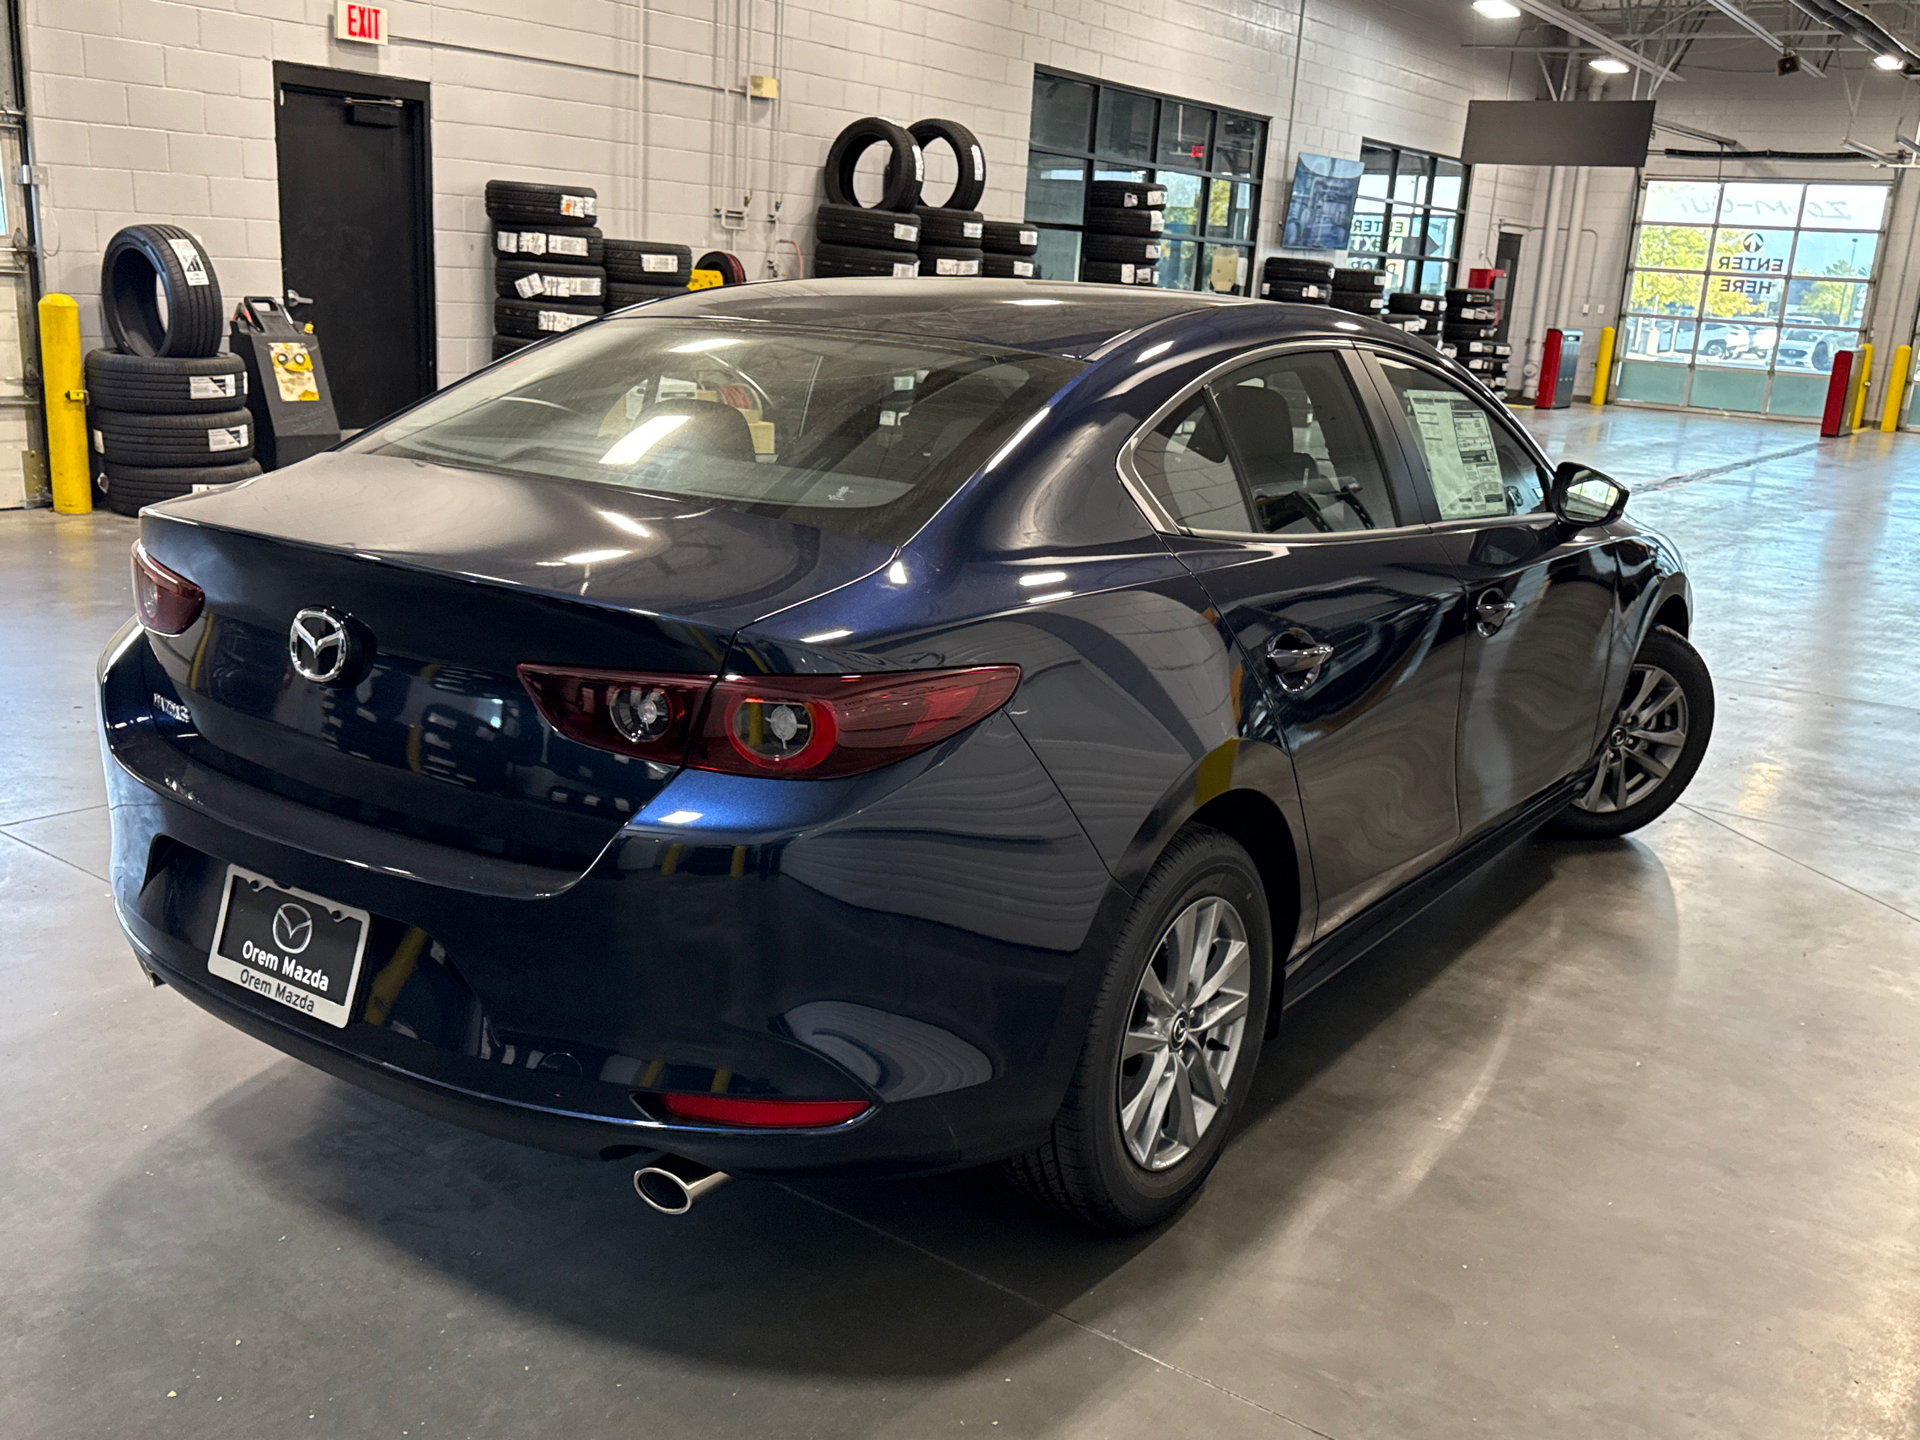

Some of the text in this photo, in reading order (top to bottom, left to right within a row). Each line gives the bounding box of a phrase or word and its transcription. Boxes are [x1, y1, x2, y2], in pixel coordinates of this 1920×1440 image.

[347, 4, 381, 40] EXIT
[242, 940, 329, 992] Orem Mazda
[240, 969, 315, 1013] Orem Mazda
